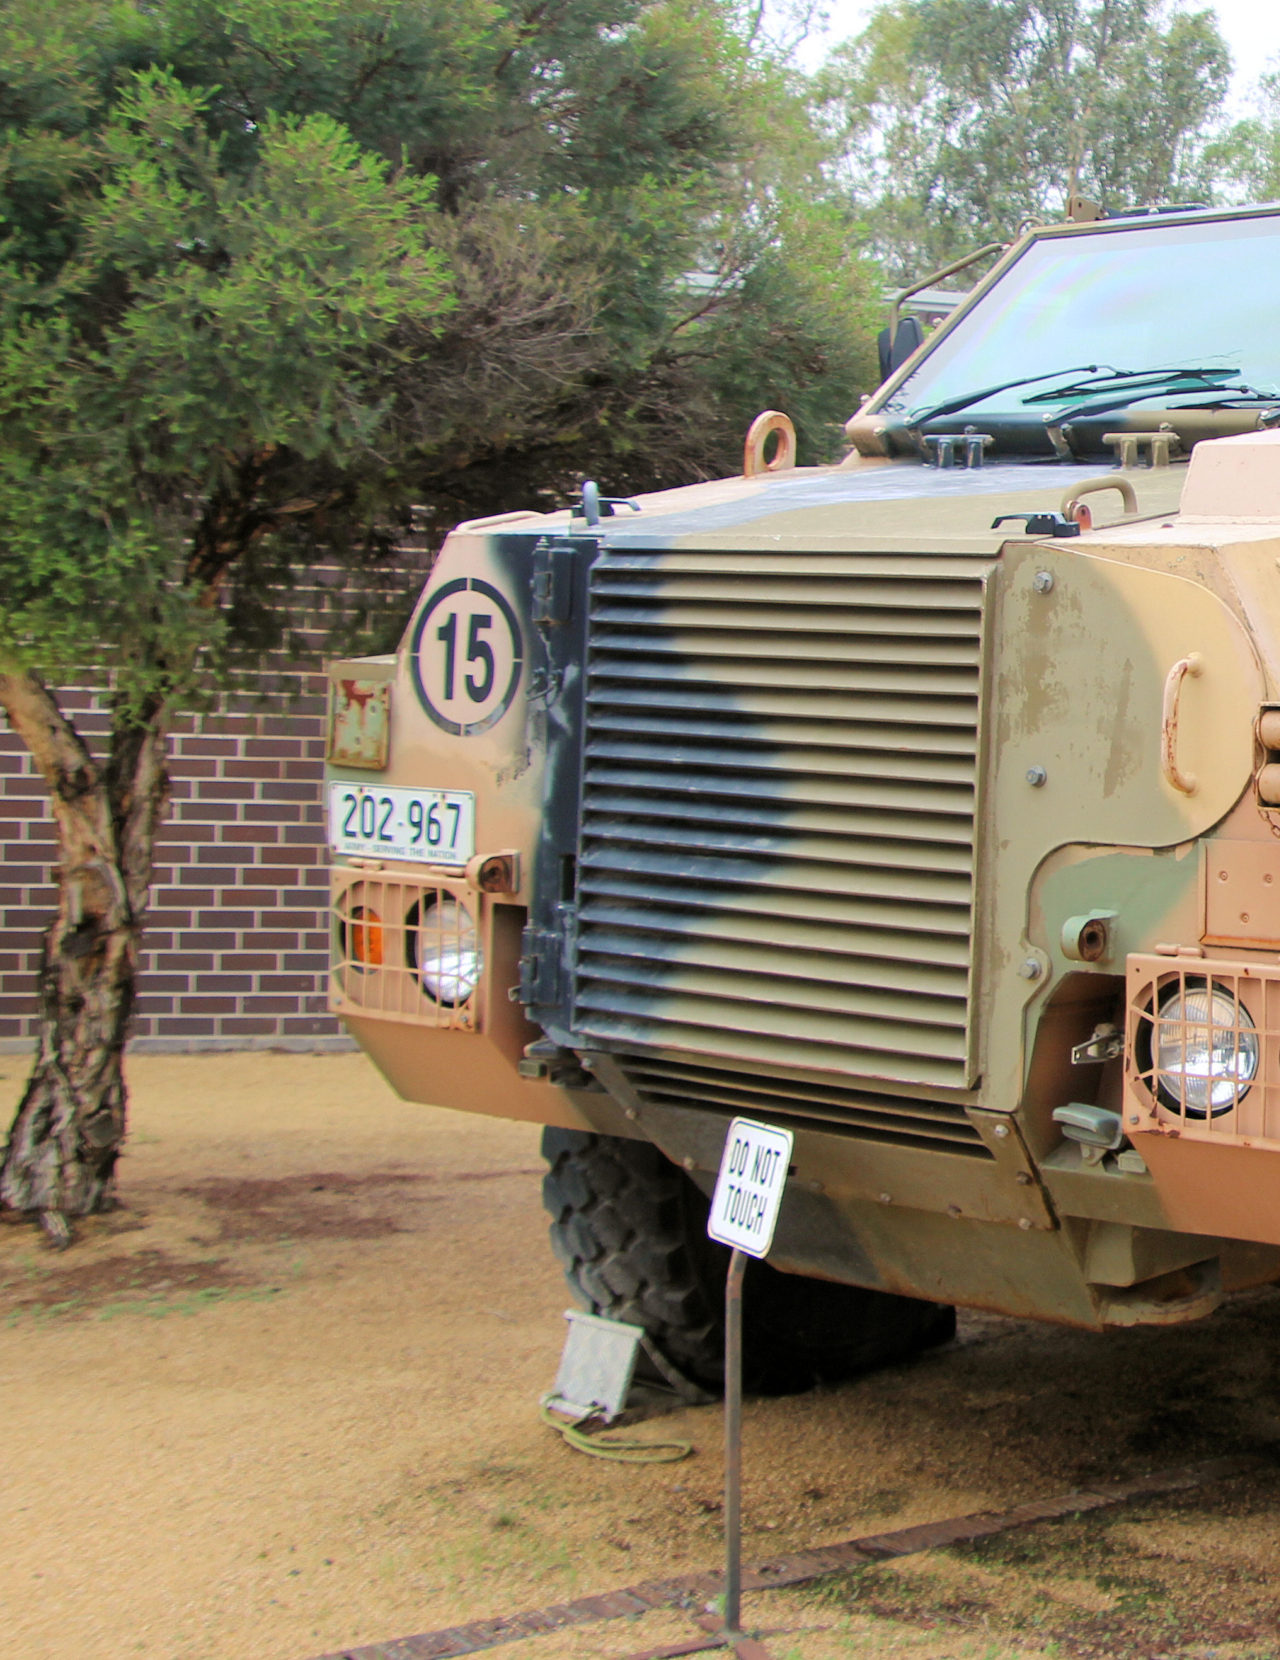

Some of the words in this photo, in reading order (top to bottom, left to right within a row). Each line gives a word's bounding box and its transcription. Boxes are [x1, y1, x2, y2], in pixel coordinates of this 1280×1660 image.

[437, 612, 495, 703] 15
[342, 793, 461, 848] 202-967
[344, 842, 365, 851] ARMY
[373, 844, 405, 856] SERVING
[410, 847, 424, 857] THE
[428, 849, 457, 860] NATION
[728, 1137, 750, 1177] DO
[750, 1144, 781, 1189] NOT
[723, 1184, 768, 1235] TOUCH
